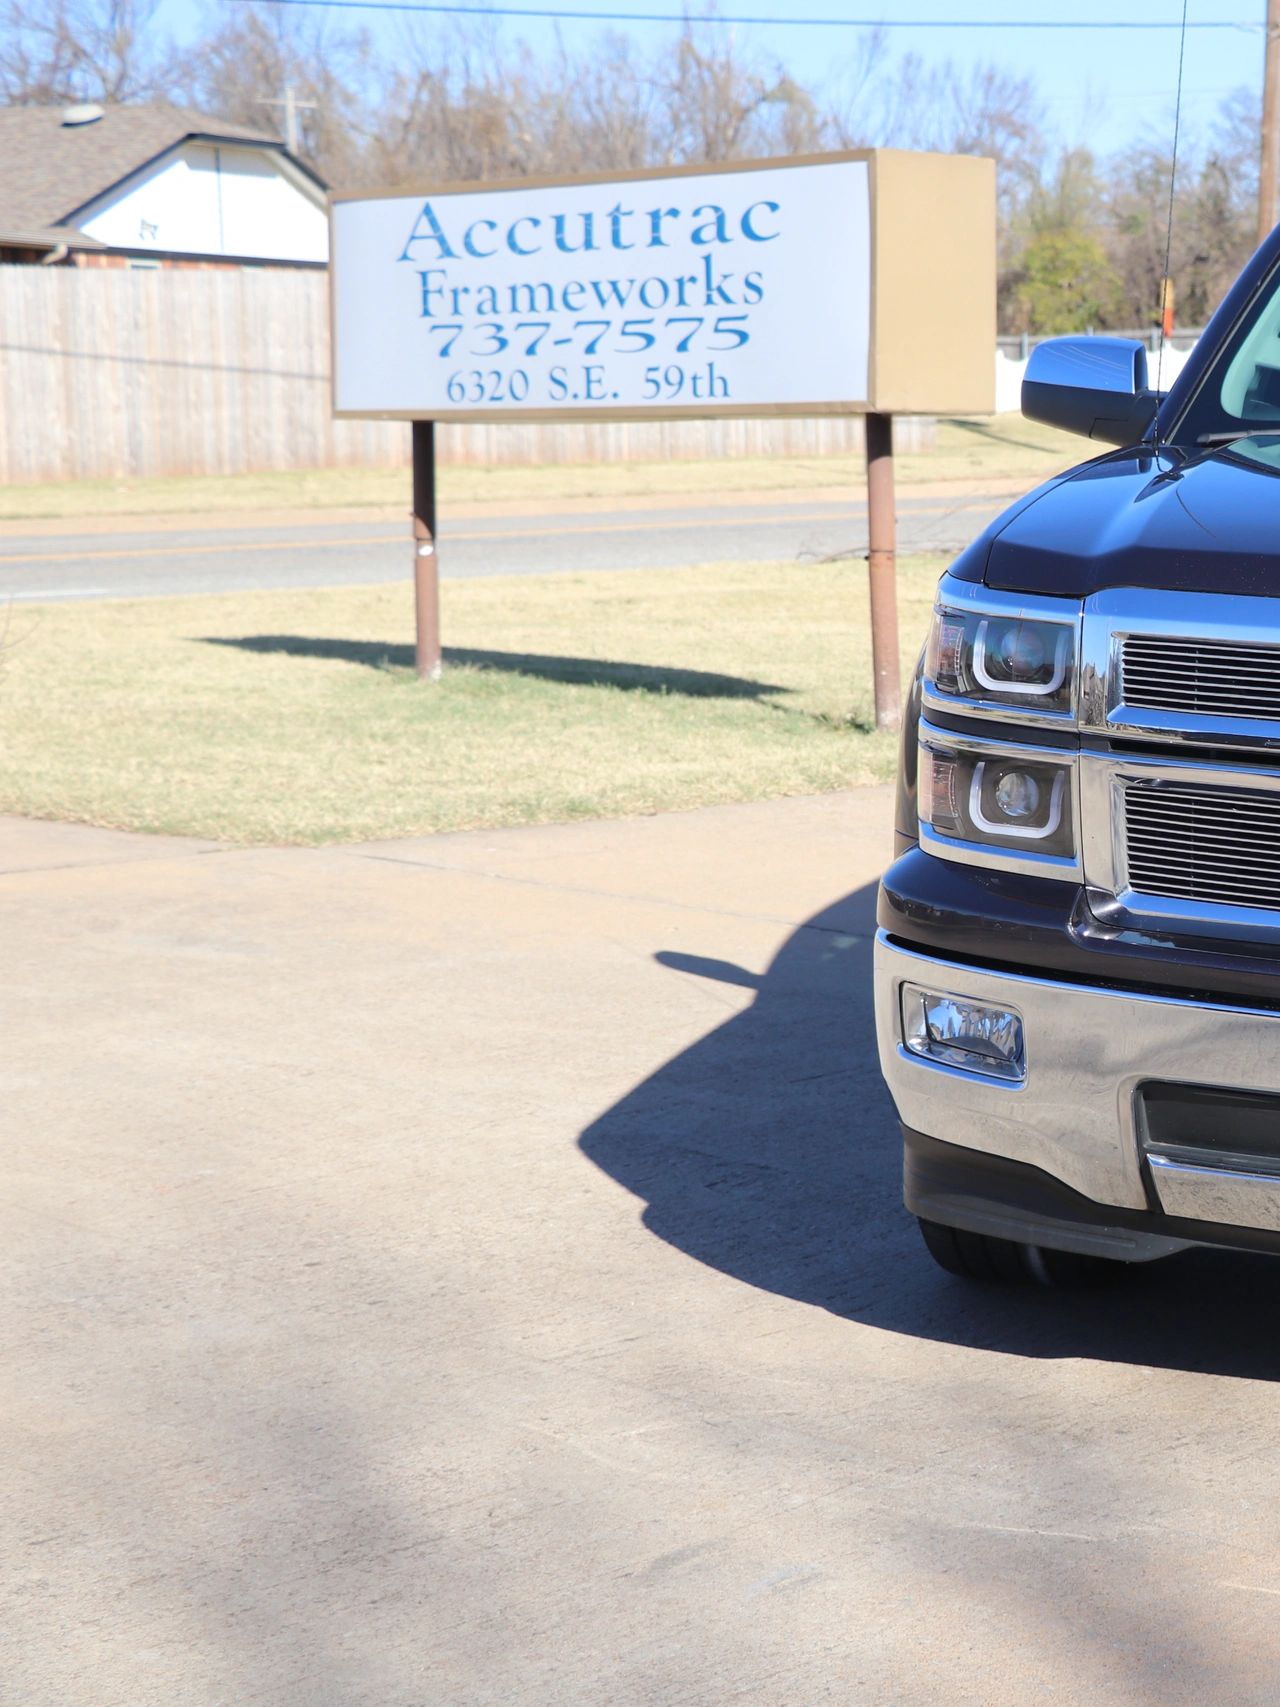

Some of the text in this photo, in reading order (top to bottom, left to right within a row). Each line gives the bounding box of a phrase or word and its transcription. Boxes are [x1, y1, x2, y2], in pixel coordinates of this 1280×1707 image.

[396, 199, 782, 263] Accutrac
[416, 252, 765, 319] Frameworks
[428, 313, 752, 360] 737-7575
[446, 360, 732, 403] 6320 S.E. 59th
